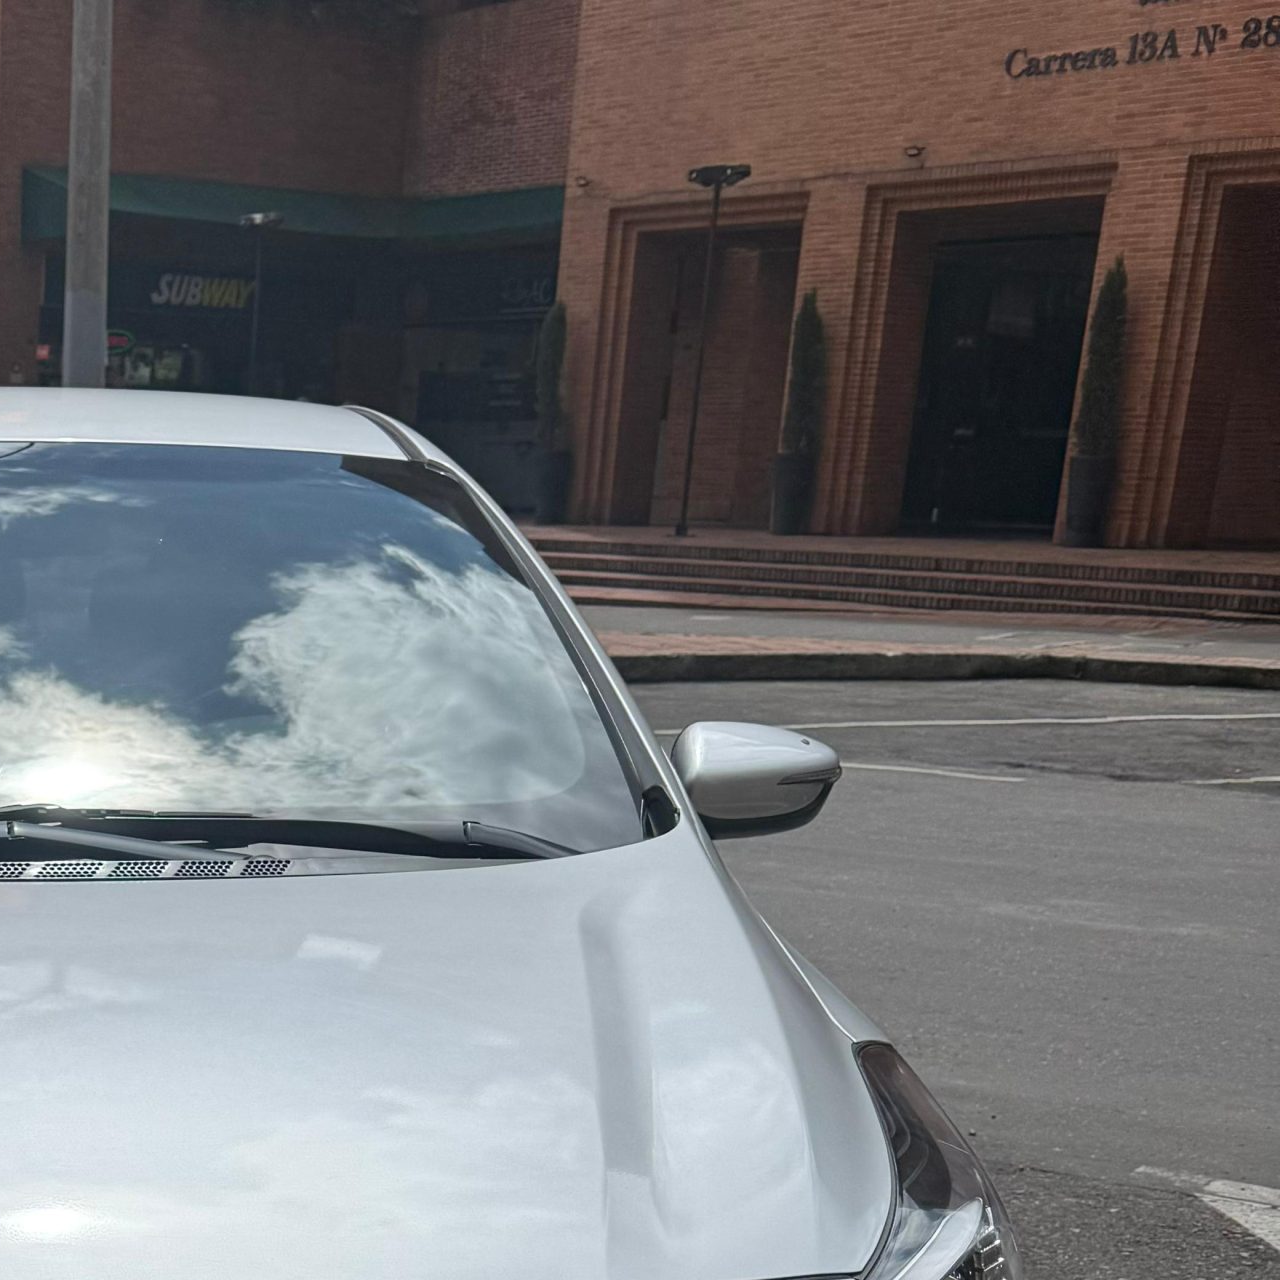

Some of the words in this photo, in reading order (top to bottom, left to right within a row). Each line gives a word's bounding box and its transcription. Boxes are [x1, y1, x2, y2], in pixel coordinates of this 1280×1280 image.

[1005, 47, 1118, 80] Carrera
[1126, 28, 1181, 65] 13A
[150, 274, 257, 309] SUBWAY
